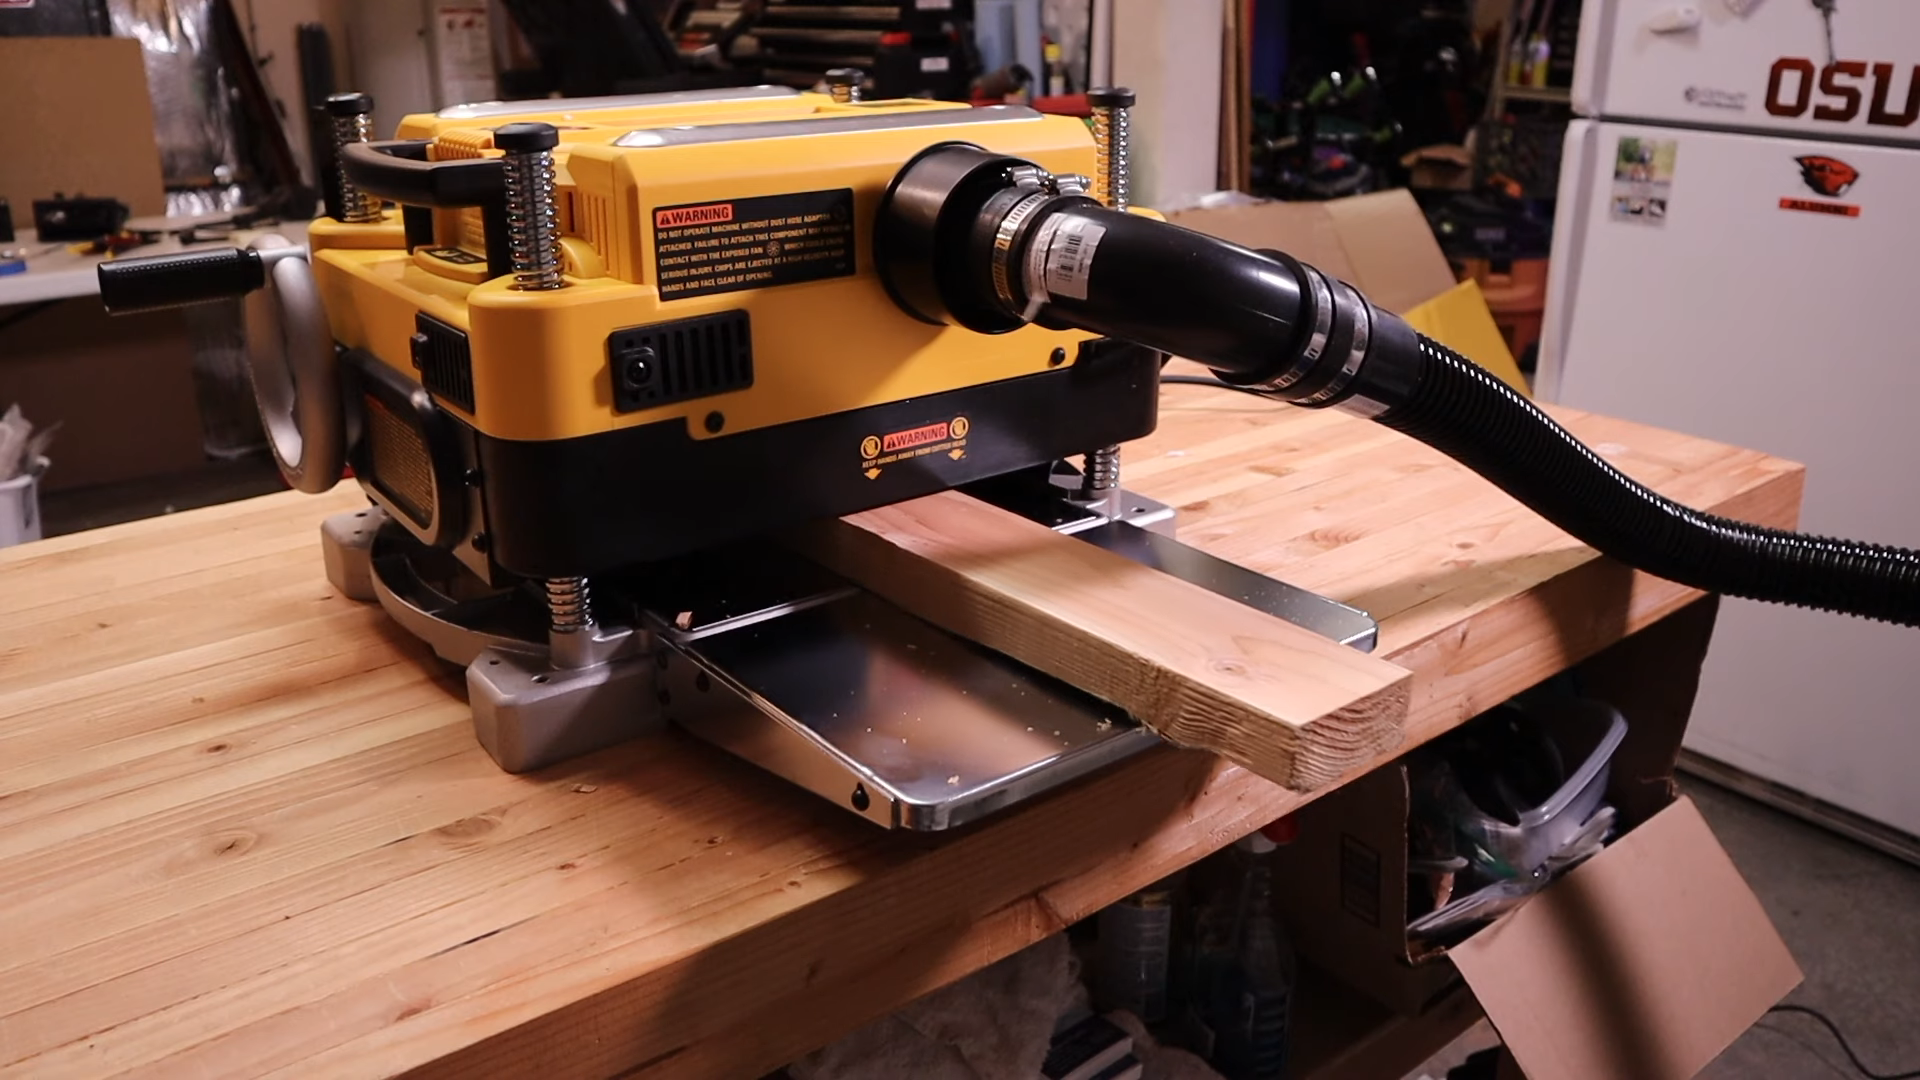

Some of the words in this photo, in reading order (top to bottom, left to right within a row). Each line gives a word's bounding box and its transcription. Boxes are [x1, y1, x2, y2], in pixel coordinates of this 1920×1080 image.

[1764, 55, 1920, 128] OSU
[671, 207, 729, 223] WARNING
[1789, 200, 1848, 215] ALUMNI
[683, 227, 710, 236] OPERATE
[712, 224, 740, 232] MACHINE
[741, 220, 768, 229] WITHOUT
[787, 216, 802, 225] HOSE
[770, 228, 807, 239] COMPONENT
[660, 257, 689, 266] CONTACT
[722, 249, 749, 257] EXPOSED
[661, 270, 688, 279] SERIOUS
[748, 259, 772, 268] EJECTED
[662, 284, 684, 292] HANDS
[896, 426, 944, 446] WARNING
[878, 455, 897, 464] HANDS
